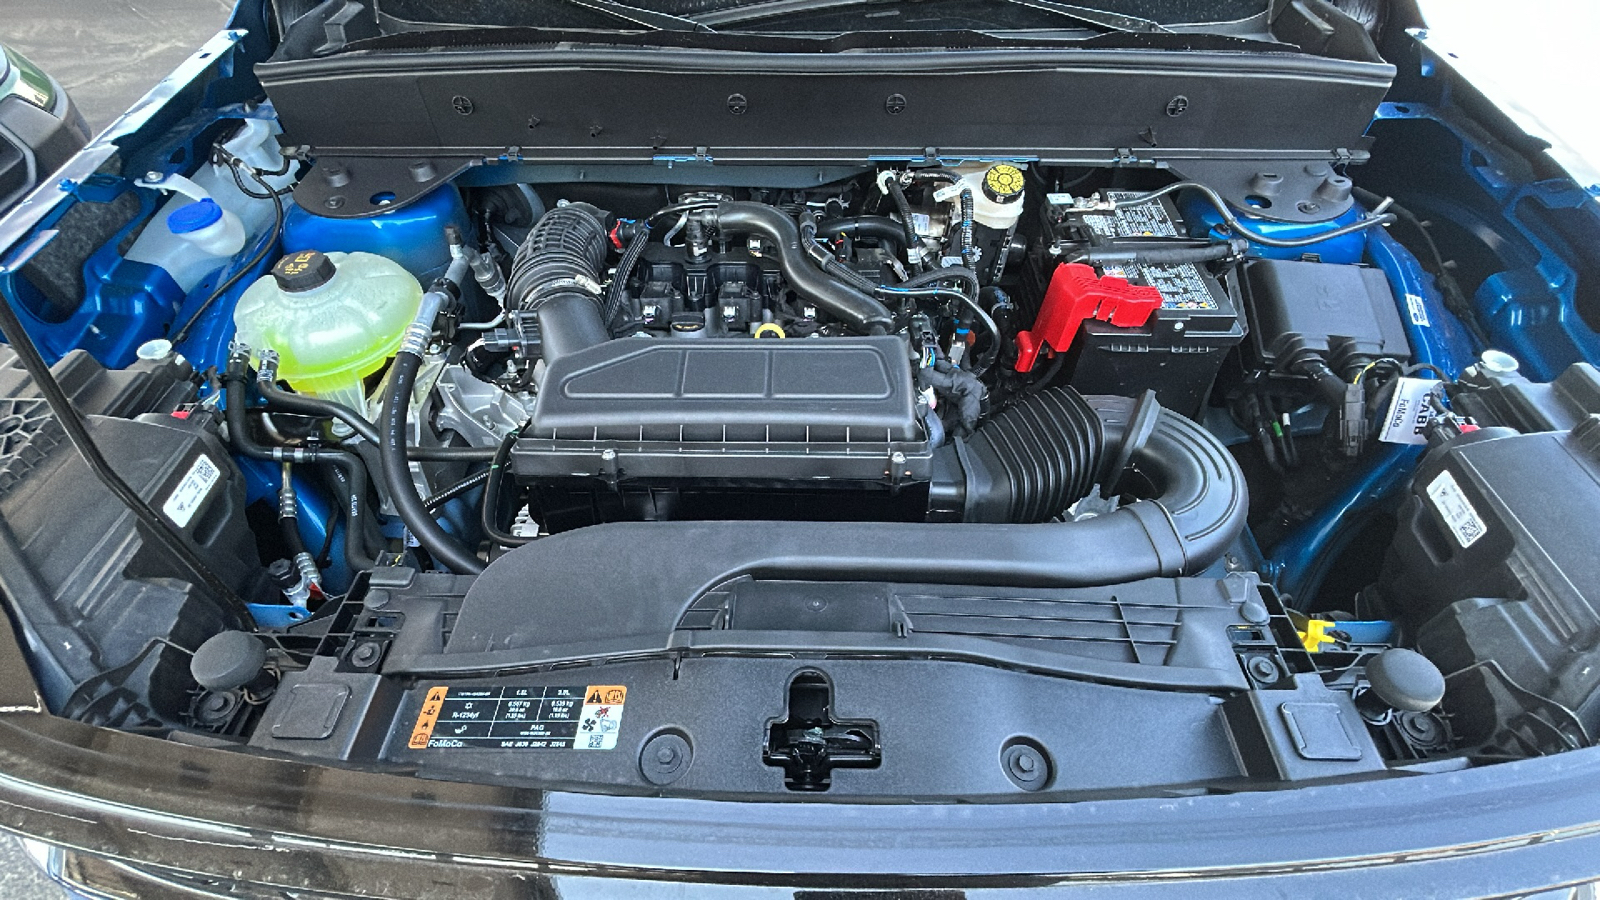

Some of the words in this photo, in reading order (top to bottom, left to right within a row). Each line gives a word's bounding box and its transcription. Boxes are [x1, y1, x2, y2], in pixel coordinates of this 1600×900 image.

[1393, 399, 1410, 428] FoMoCo
[451, 711, 480, 719] R-1234yf
[428, 739, 463, 748] FoMoCo
